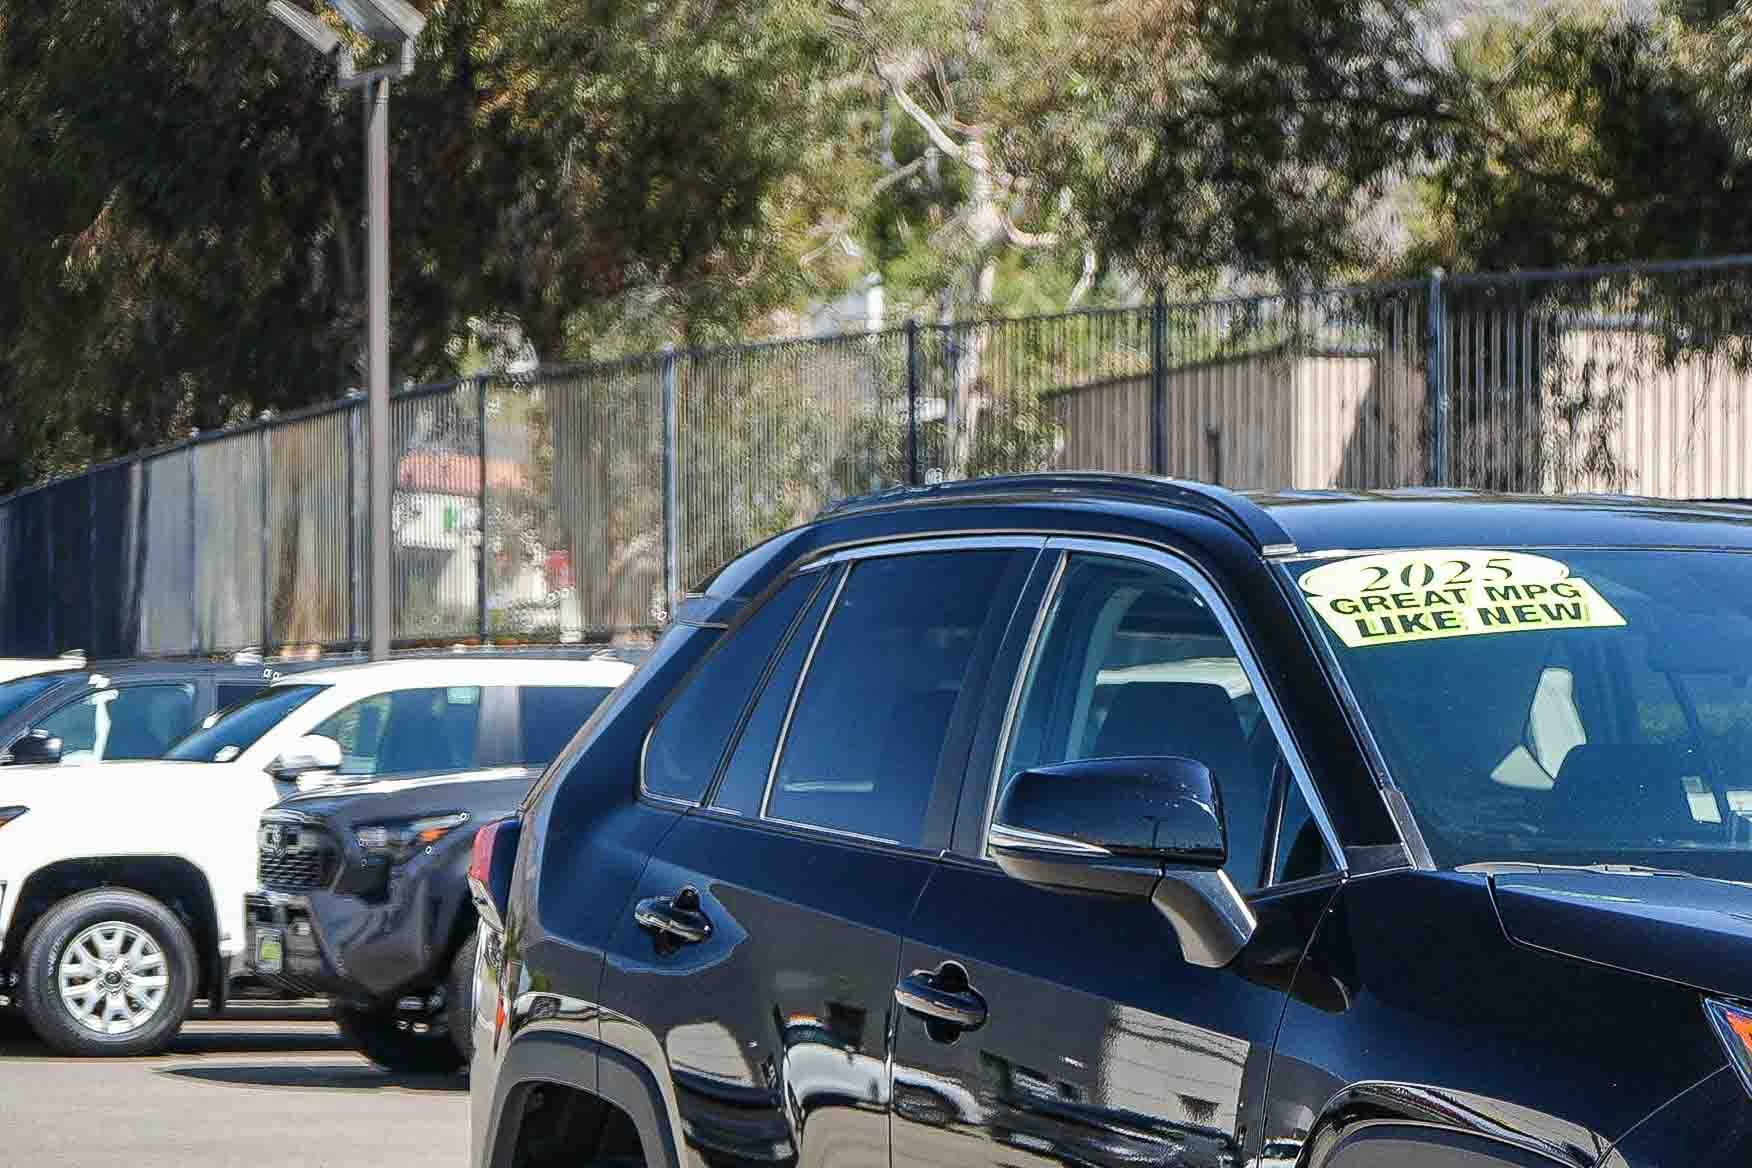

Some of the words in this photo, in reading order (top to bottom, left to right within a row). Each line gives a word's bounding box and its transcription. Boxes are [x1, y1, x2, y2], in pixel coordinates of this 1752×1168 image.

[1360, 558, 1513, 593] 2025
[1329, 587, 1467, 615] GREAT
[1484, 583, 1583, 602] MPG
[1354, 610, 1461, 638] LIKE
[1478, 602, 1583, 626] NEW
